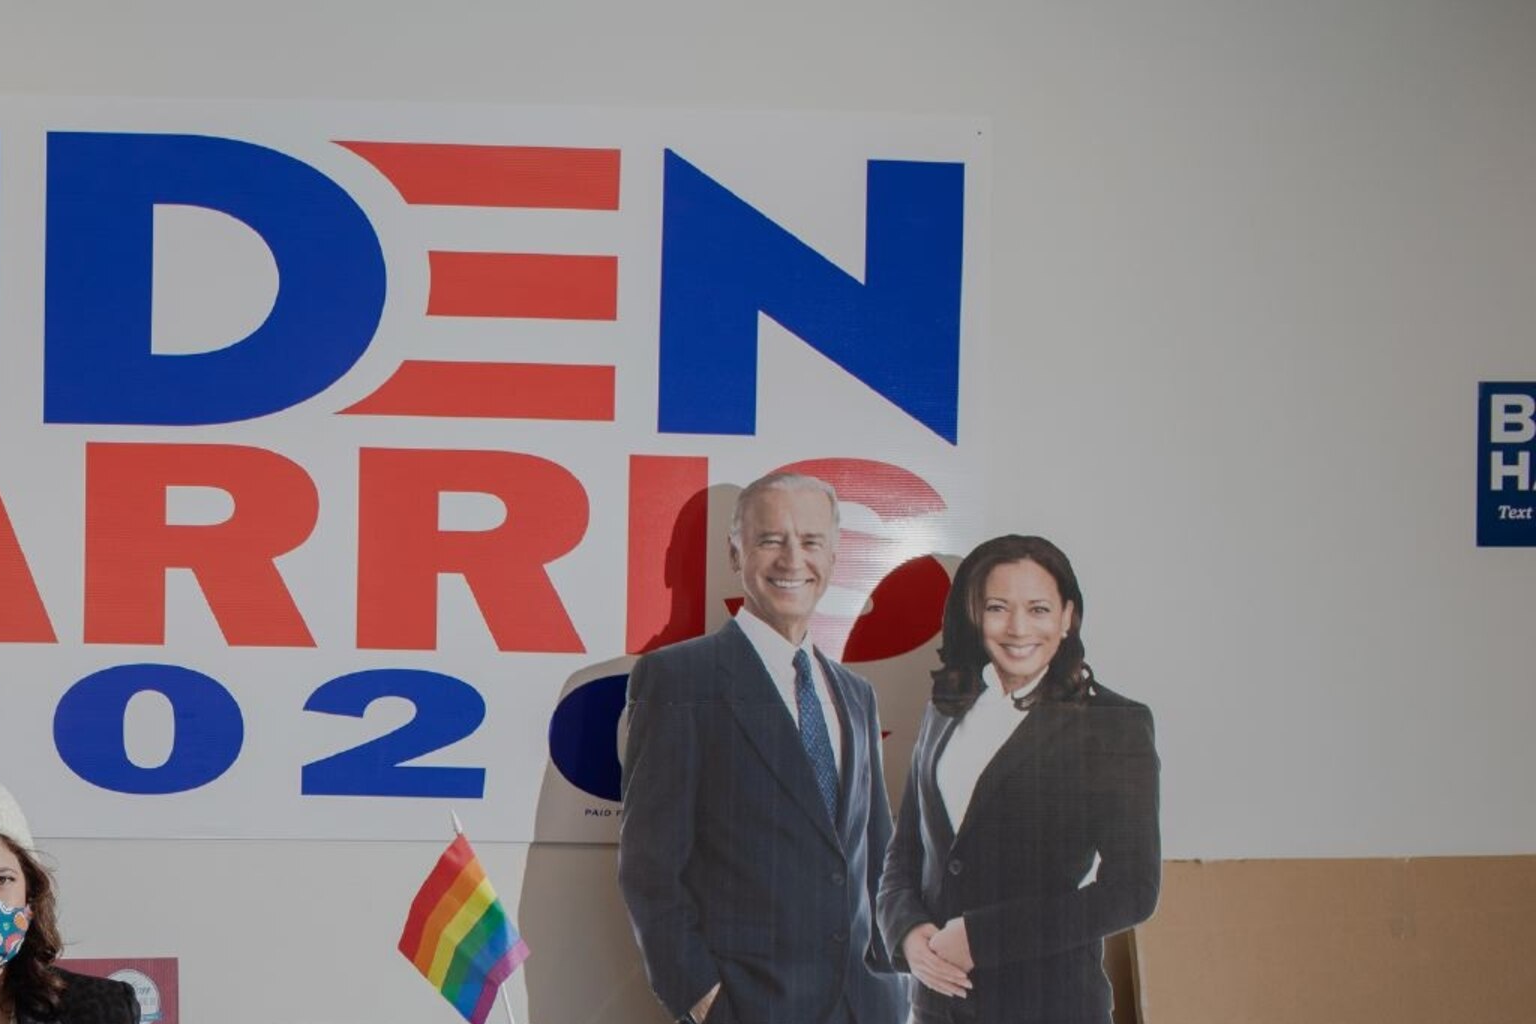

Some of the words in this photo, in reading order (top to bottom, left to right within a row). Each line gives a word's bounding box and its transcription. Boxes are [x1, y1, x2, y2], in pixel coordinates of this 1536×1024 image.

[1490, 451, 1536, 491] H
[1498, 505, 1533, 519] Text
[584, 809, 612, 817] PAID
